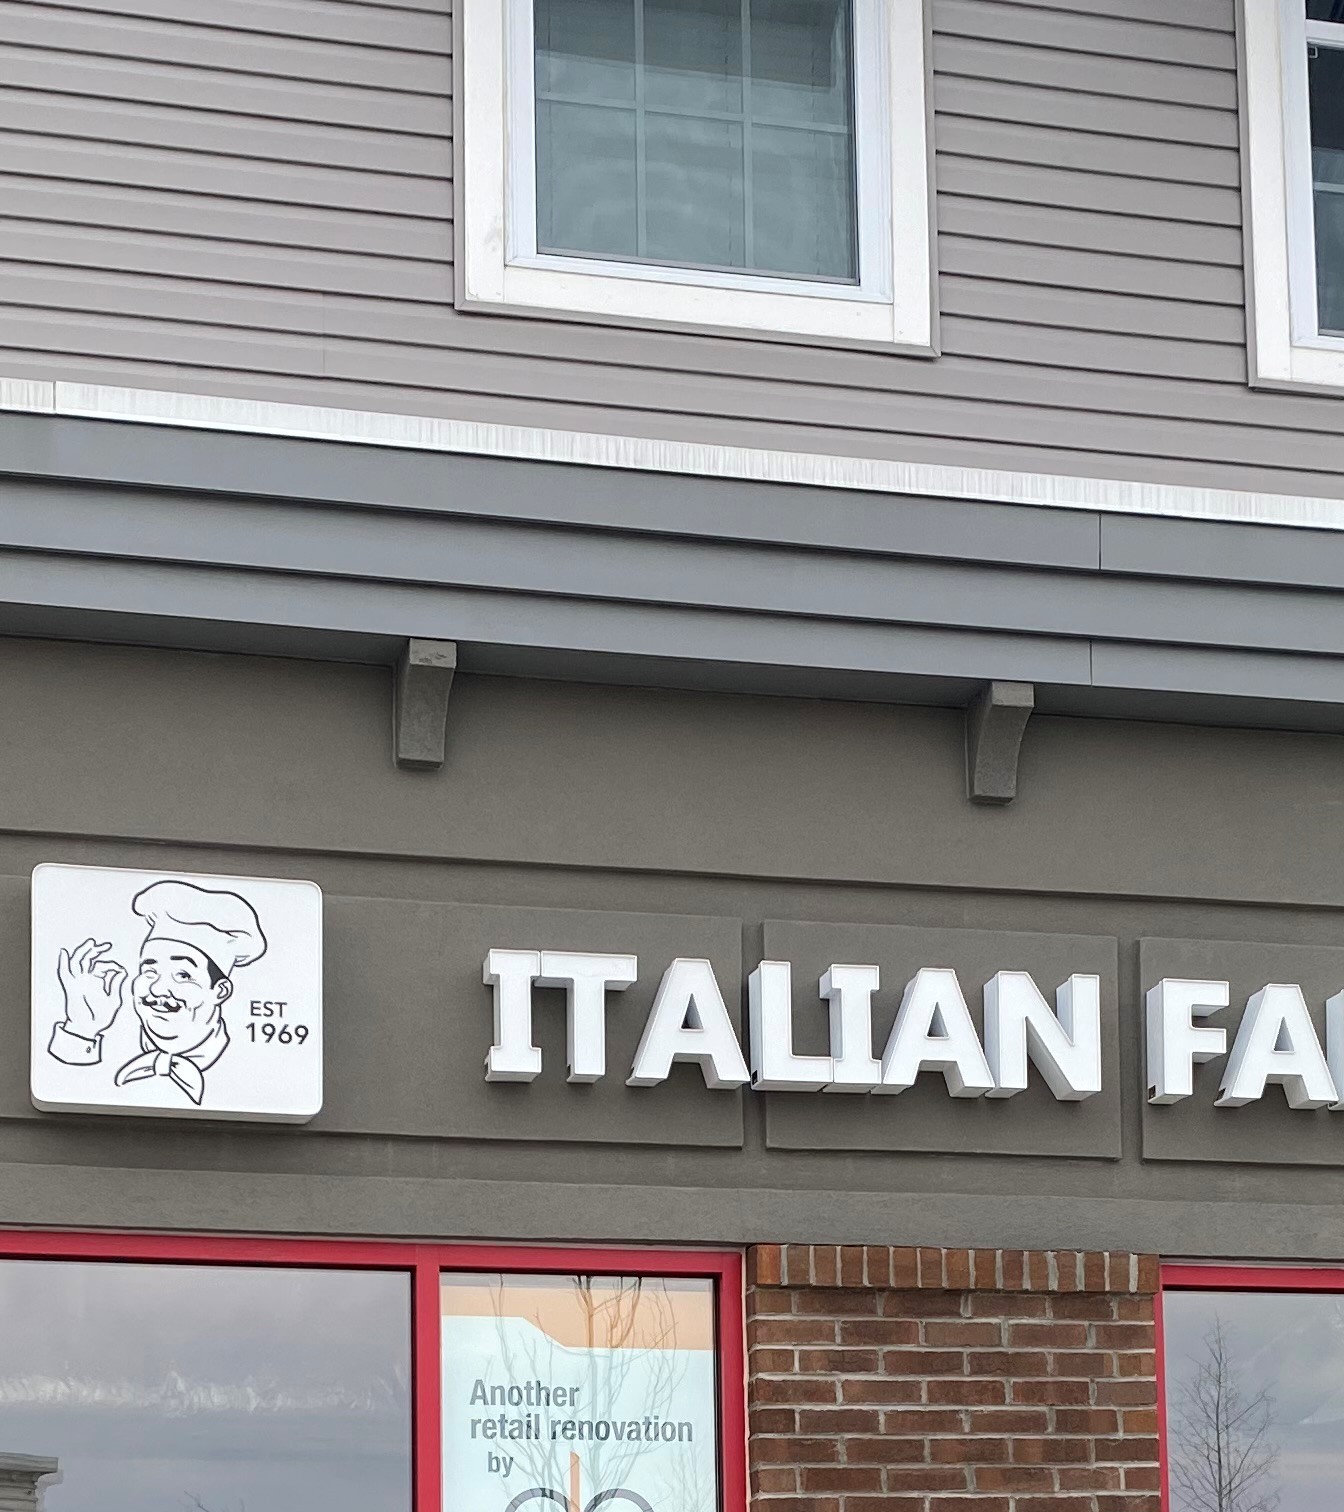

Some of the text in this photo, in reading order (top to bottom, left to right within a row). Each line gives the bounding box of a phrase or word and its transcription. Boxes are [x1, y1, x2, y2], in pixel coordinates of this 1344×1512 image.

[250, 1001, 287, 1017] EST
[246, 1023, 309, 1045] 1969
[482, 948, 1103, 1102] ITALIAN
[469, 1379, 580, 1407] Another
[470, 1413, 693, 1442] retail renovation
[487, 1451, 514, 1478] by
